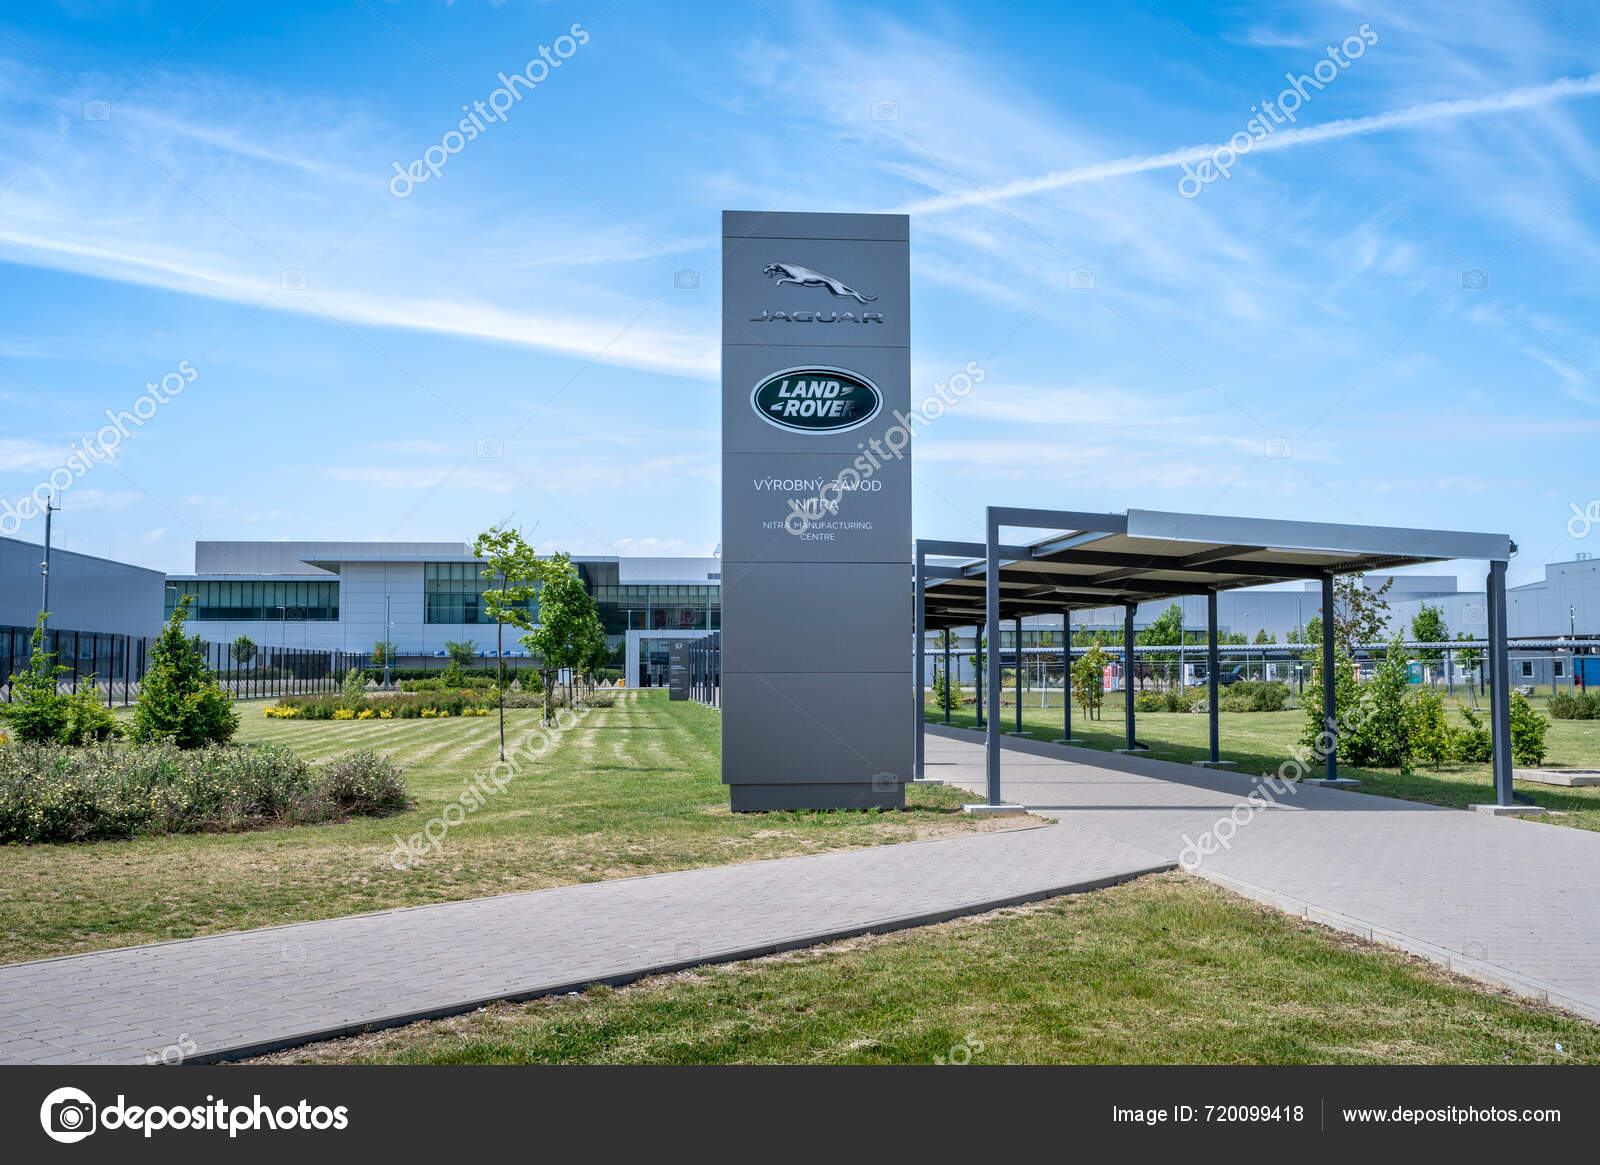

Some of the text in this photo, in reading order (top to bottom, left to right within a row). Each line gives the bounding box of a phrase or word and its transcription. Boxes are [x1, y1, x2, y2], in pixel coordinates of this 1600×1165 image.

[749, 309, 884, 324] JAGUAR
[778, 380, 841, 398] LAND
[783, 399, 857, 417] ROVER
[753, 476, 882, 492] VÝROBNÝ ZÁVOD
[795, 498, 840, 511] NITRA
[763, 521, 873, 530] NITRA MANUFACTURING
[800, 532, 836, 541] CENTRE
